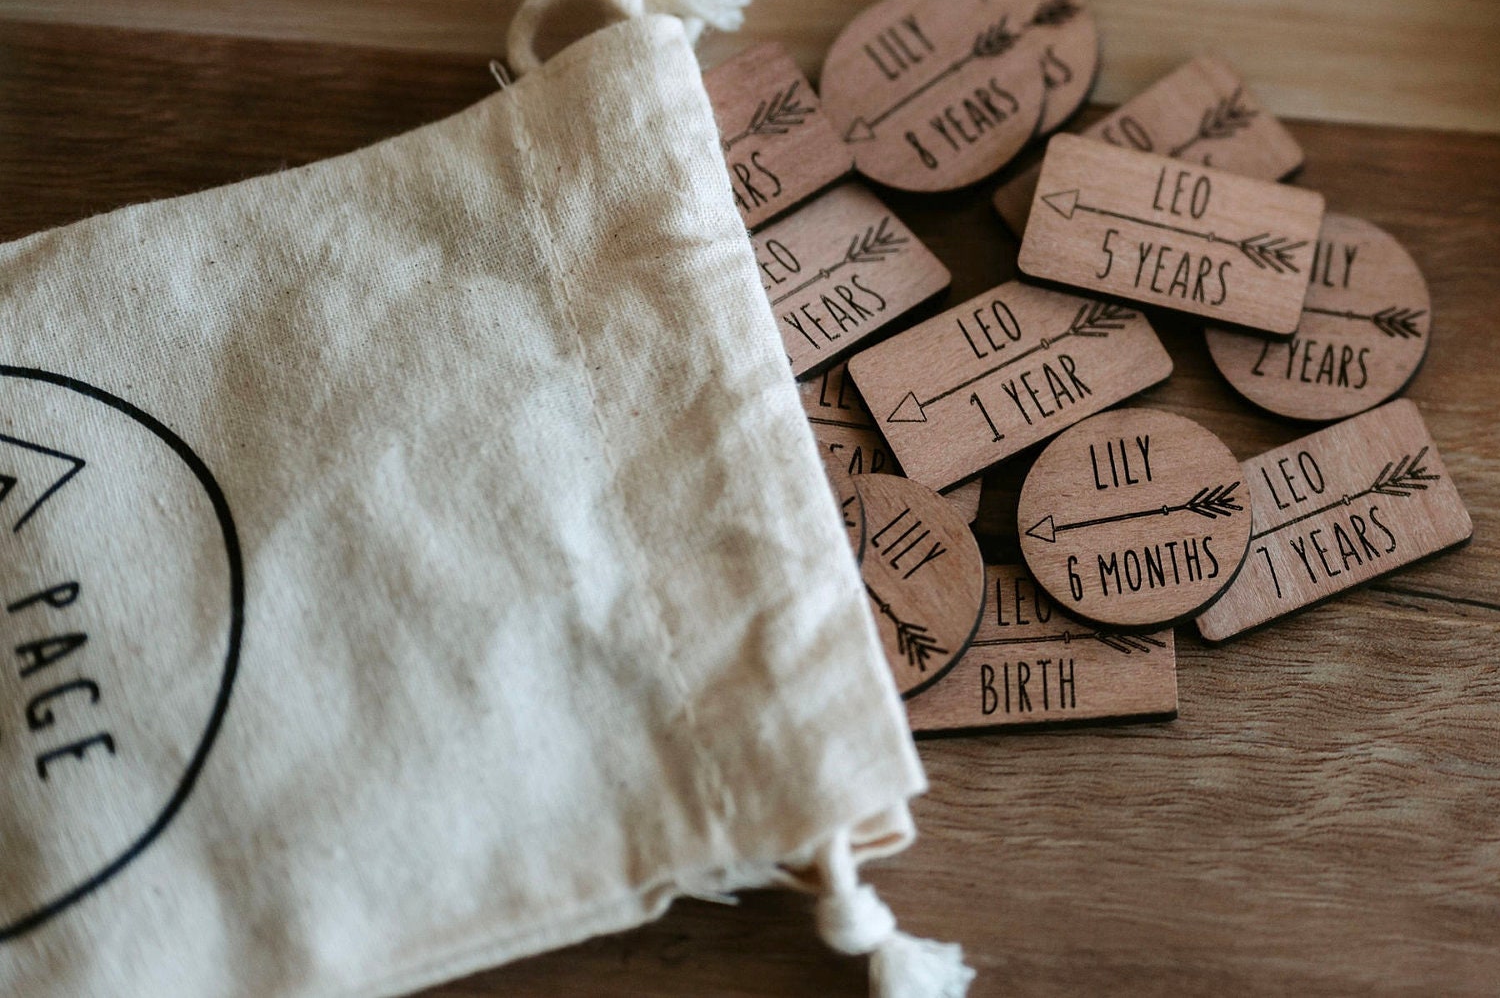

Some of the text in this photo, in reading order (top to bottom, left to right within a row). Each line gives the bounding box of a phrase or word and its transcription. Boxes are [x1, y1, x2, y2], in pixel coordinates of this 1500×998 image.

[863, 14, 937, 81] LILY
[929, 77, 1019, 152] YEARS
[1152, 166, 1211, 220] LEO
[757, 238, 801, 290] EO
[1096, 229, 1232, 307] 5 YEARS
[1309, 240, 1358, 289] ILY
[783, 274, 887, 350] YEARS
[956, 299, 1022, 360] LEO
[1285, 337, 1371, 390] YEARS
[969, 354, 1093, 443] 1 YEAR
[1090, 434, 1154, 491] LILY
[1261, 450, 1326, 511] LEO
[870, 507, 947, 580] LILY
[1067, 535, 1219, 602] 6 MONTHS
[1256, 505, 1396, 599] 7 YEARS
[995, 576, 1052, 627] LEO
[6, 581, 116, 783] PAGE
[980, 658, 1077, 716] BIRTH
